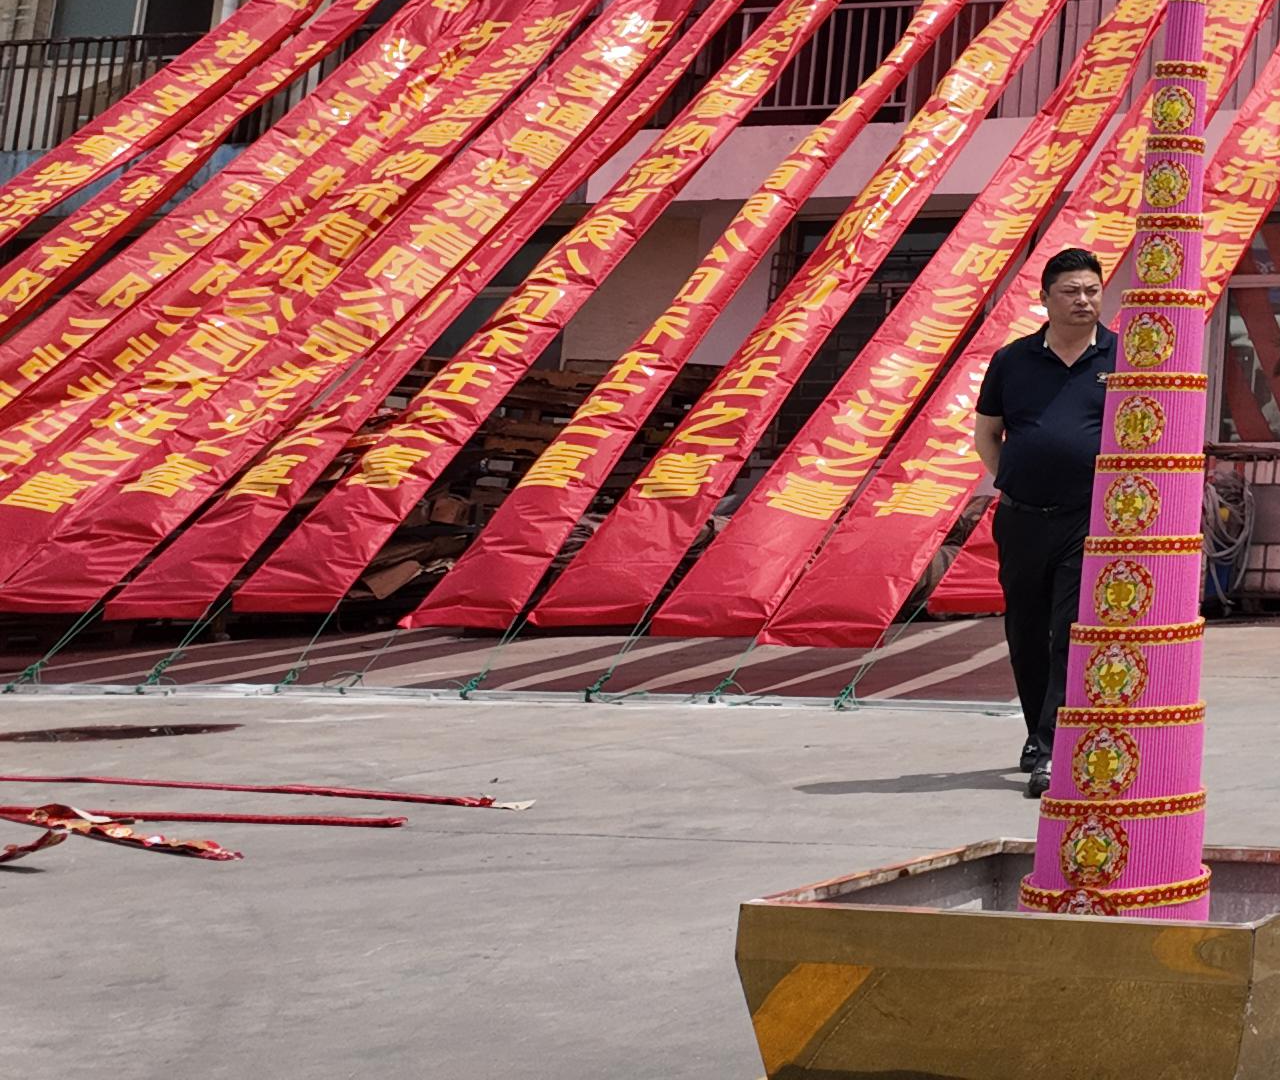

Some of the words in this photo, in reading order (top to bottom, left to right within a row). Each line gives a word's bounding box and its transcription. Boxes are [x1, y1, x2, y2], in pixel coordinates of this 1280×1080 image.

[0, 7, 581, 513] 祝海安通粤物流有限公司乔迁之喜
[120, 10, 674, 498] 祝海安通粤物流有限公司乔迁之喜
